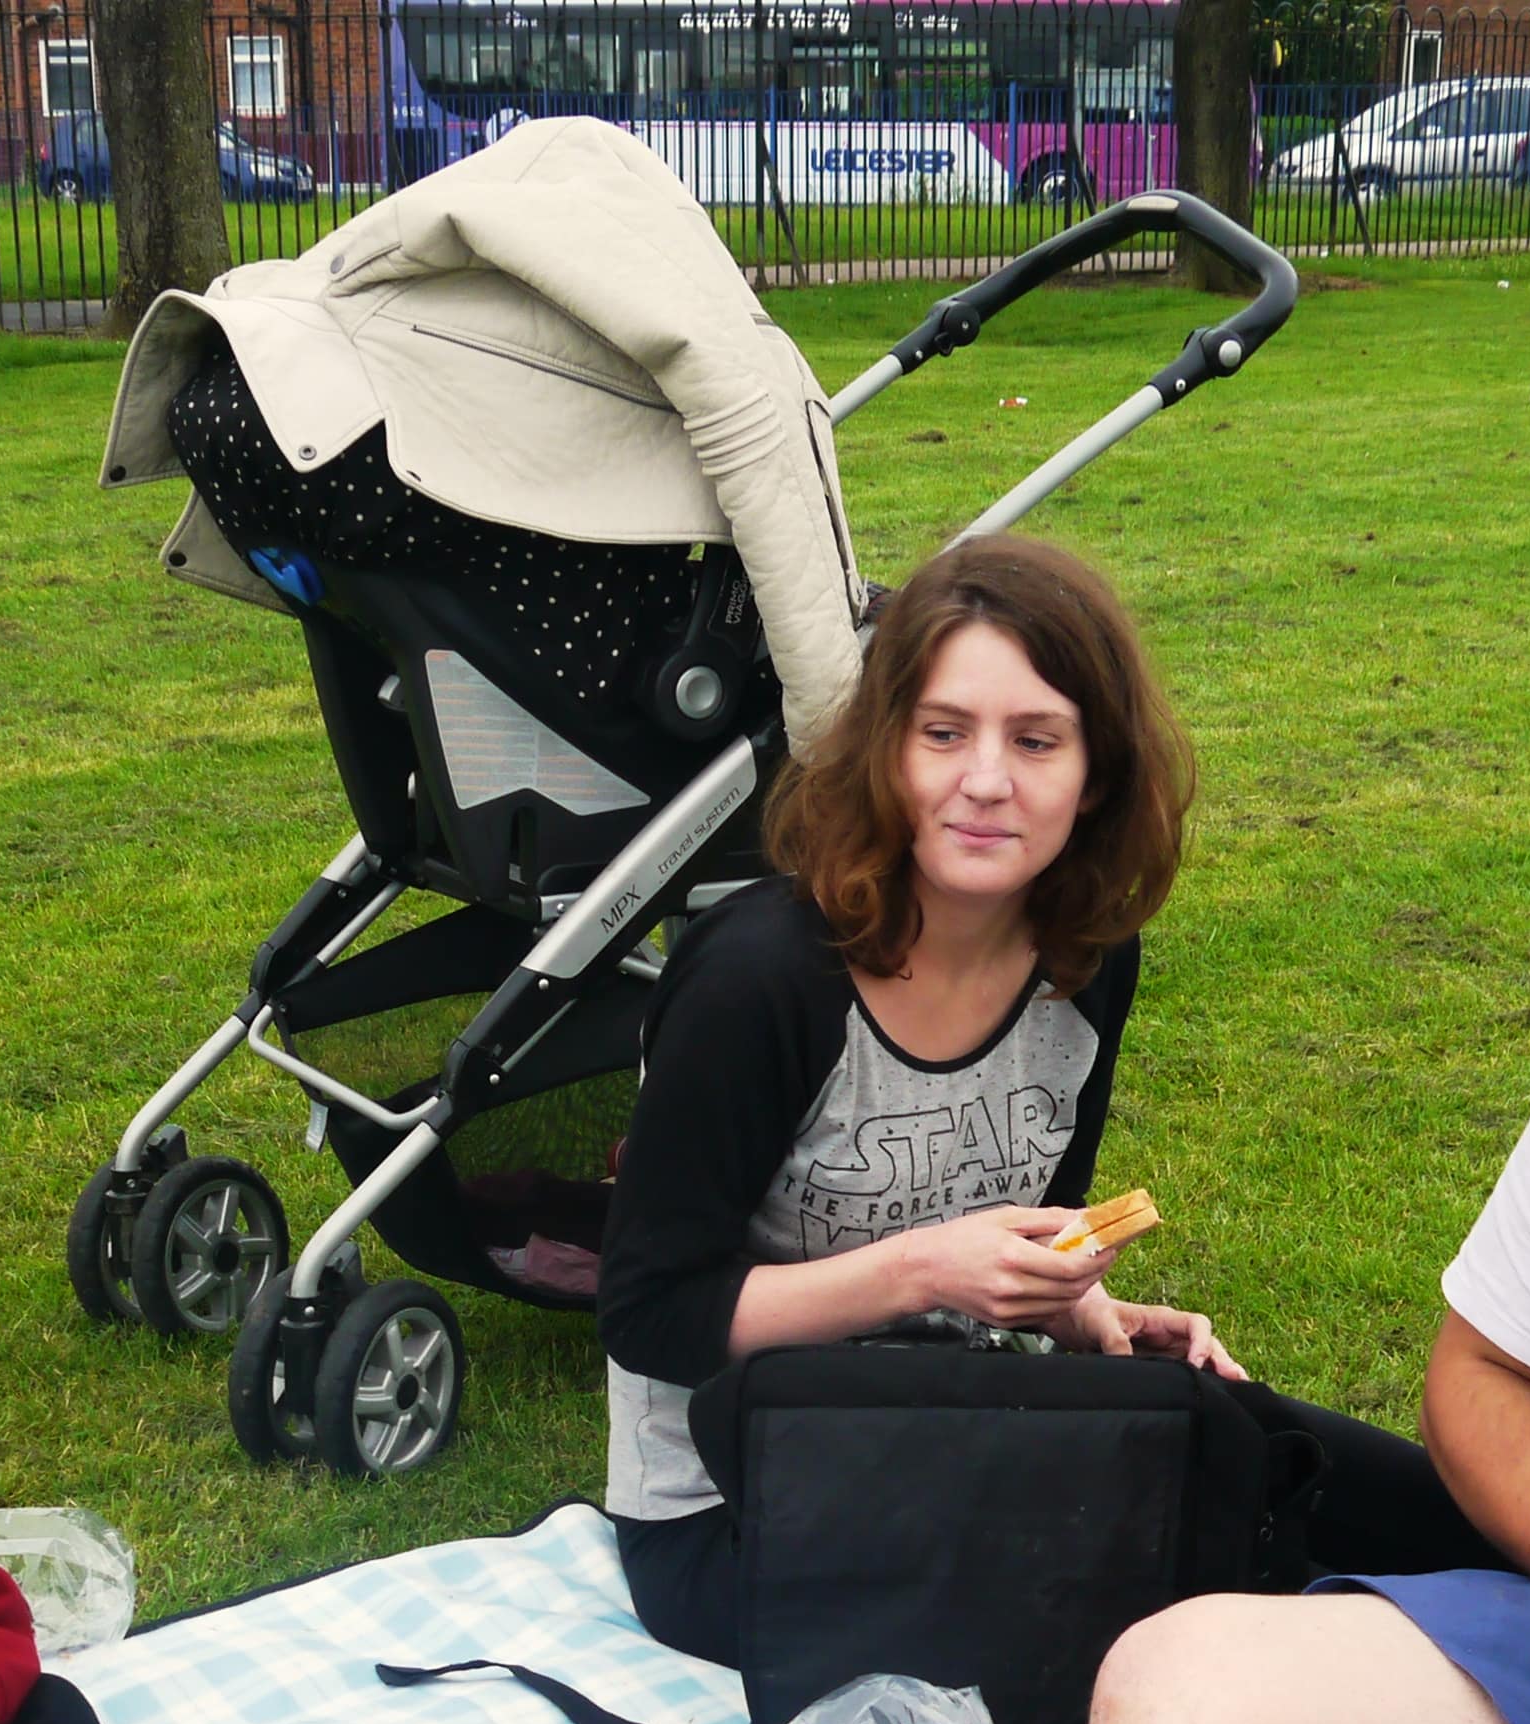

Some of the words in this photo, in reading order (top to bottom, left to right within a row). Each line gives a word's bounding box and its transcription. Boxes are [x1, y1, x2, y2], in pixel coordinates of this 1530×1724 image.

[679, 7, 757, 34] anywher
[810, 148, 955, 173] LEICESTER
[725, 579, 741, 624] PRIMO
[657, 832, 694, 875] travel
[694, 786, 741, 838] system
[599, 884, 642, 934] MPX
[806, 1084, 1075, 1196] STAR
[784, 1173, 839, 1217] THE
[867, 1186, 954, 1222] FORCE
